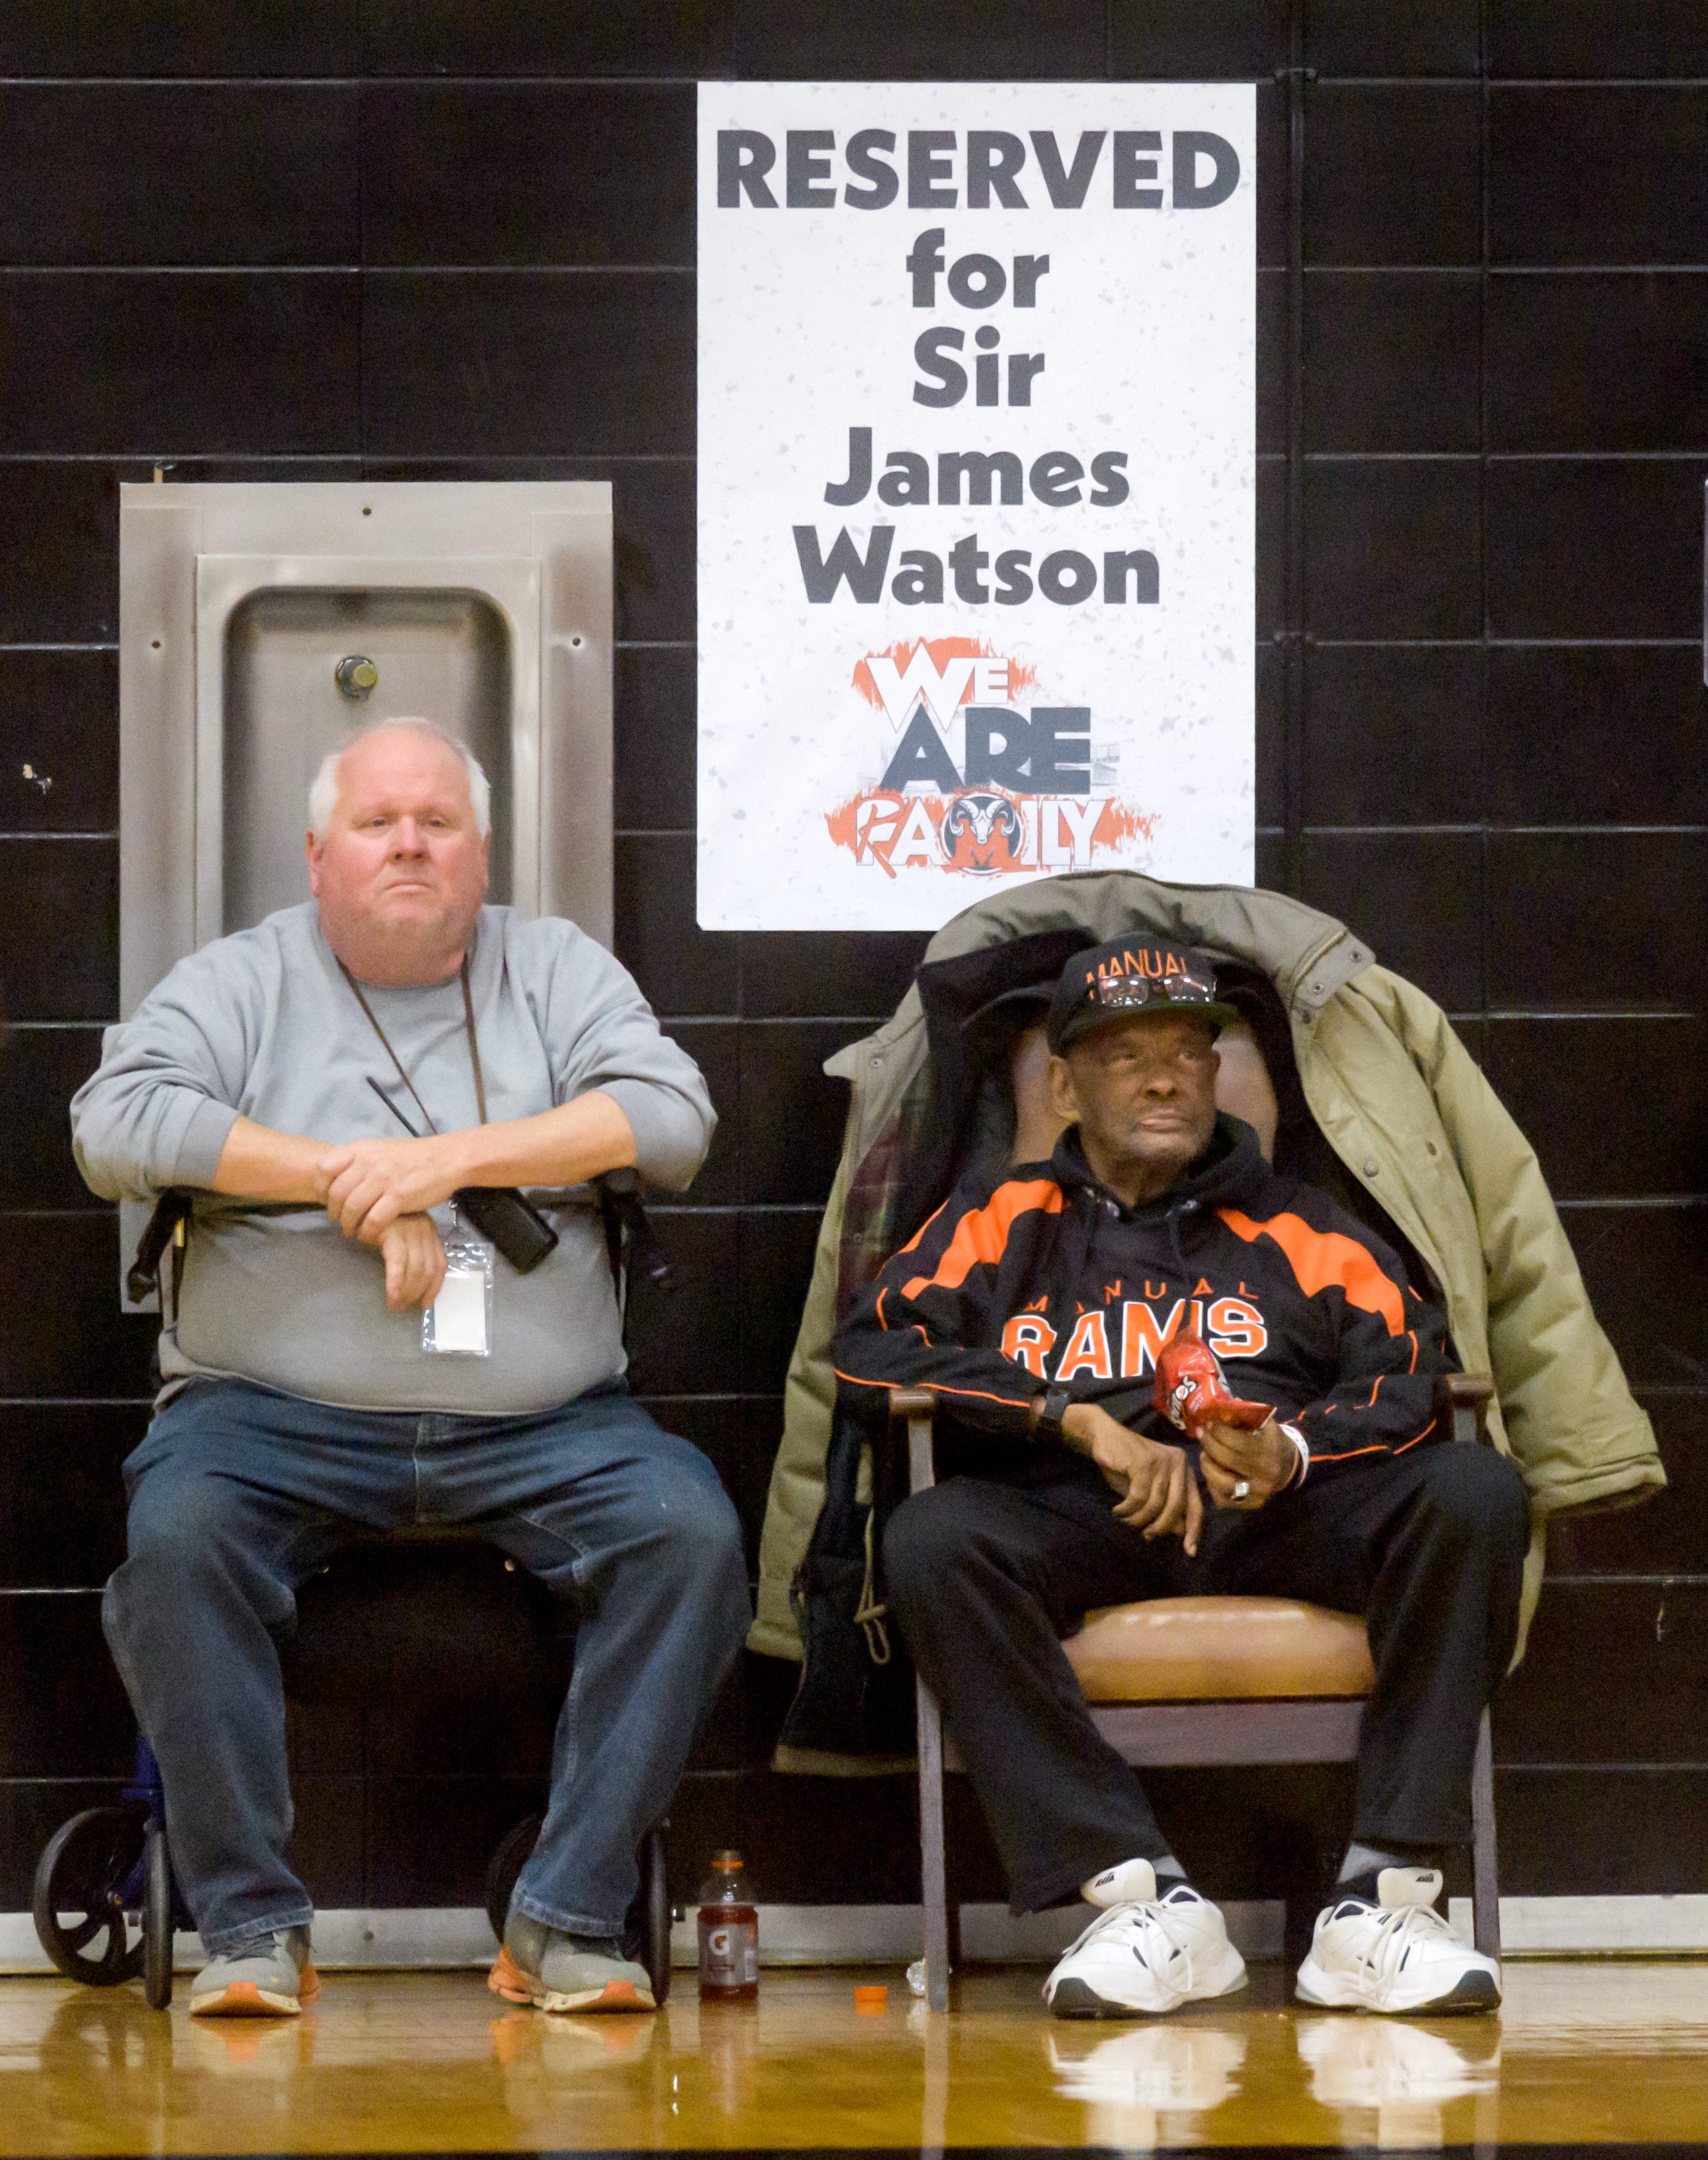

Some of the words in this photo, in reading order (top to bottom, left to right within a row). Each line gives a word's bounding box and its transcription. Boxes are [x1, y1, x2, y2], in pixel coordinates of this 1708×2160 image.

[717, 129, 1240, 210] RESERVED
[906, 228, 1050, 309] for
[913, 325, 1045, 408] Sir
[824, 426, 1129, 507] James
[792, 525, 1160, 606] Watson
[864, 642, 1009, 733] WE
[880, 704, 1091, 795] ARE
[855, 794, 1108, 871] FAMILY
[1001, 1297, 1268, 1381] RAMS
[709, 1930, 730, 1956] G
